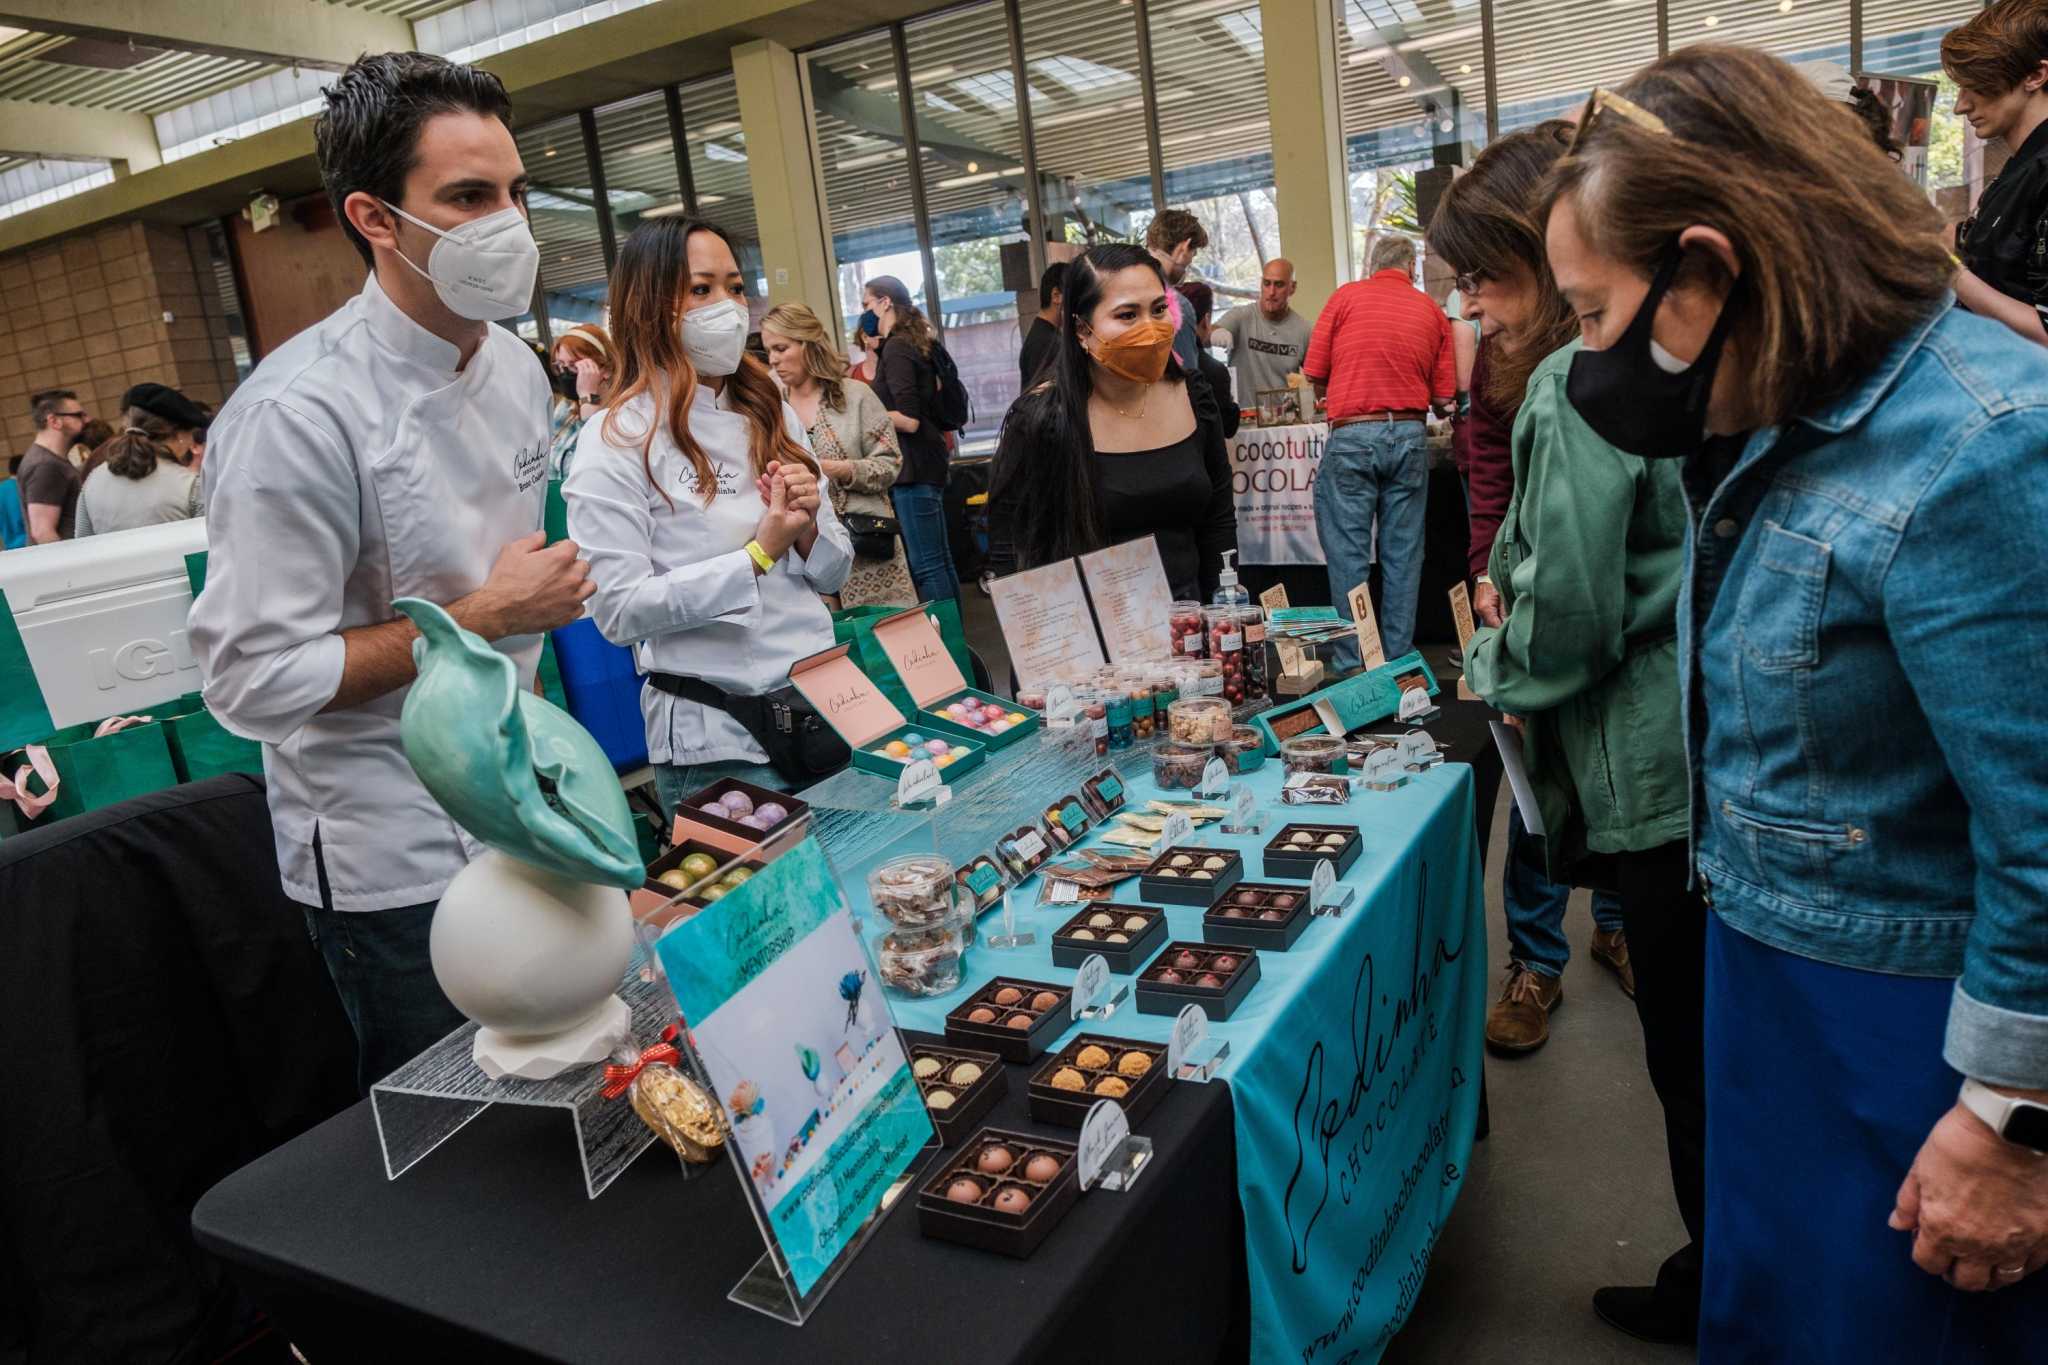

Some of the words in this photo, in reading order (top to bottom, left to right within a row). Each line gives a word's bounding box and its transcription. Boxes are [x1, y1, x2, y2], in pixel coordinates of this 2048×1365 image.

[1236, 433, 1324, 462] cocotutti
[1232, 467, 1317, 494] OCOLA
[88, 629, 201, 691] IGL
[738, 926, 796, 983] MENTORSHIP
[1340, 1011, 1439, 1206] CHOCOLATE
